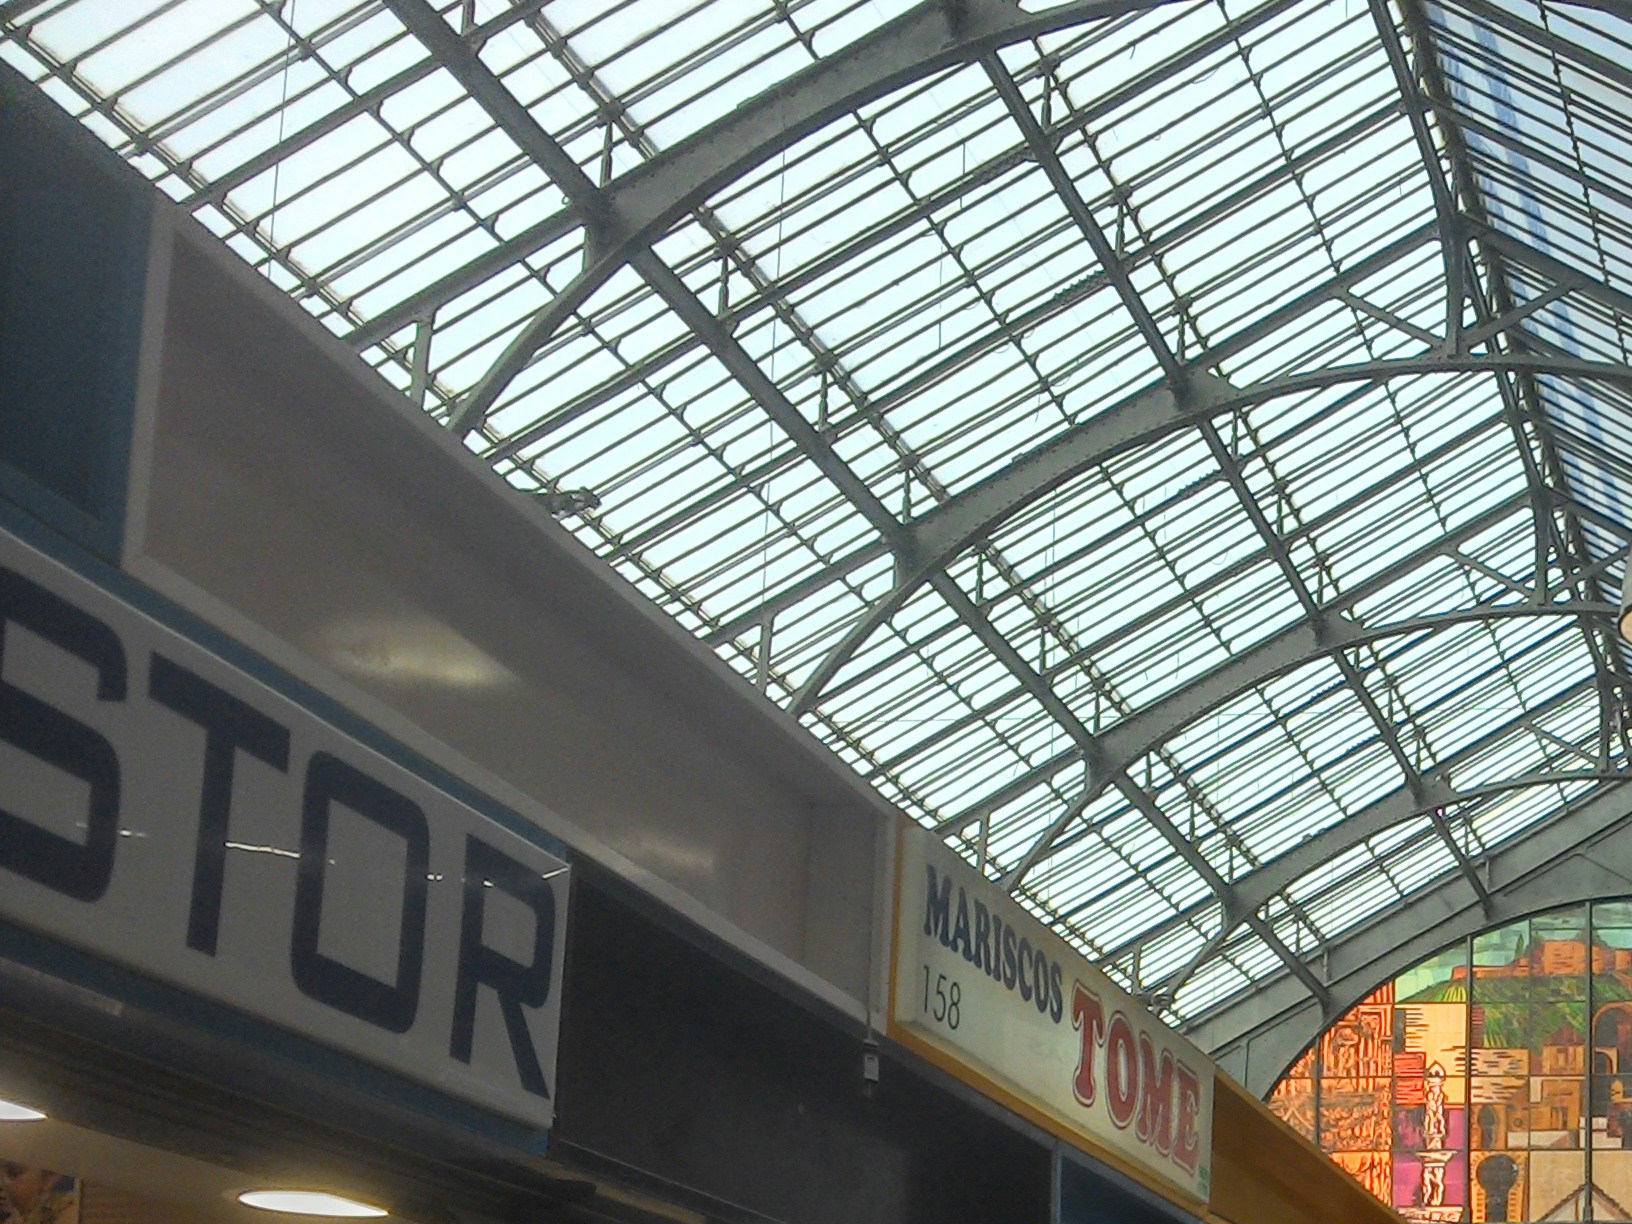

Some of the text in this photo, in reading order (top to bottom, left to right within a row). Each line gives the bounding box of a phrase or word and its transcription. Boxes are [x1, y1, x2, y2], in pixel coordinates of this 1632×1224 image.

[923, 965, 962, 1030] 158
[923, 864, 1200, 1177] MARISCOS TOME
